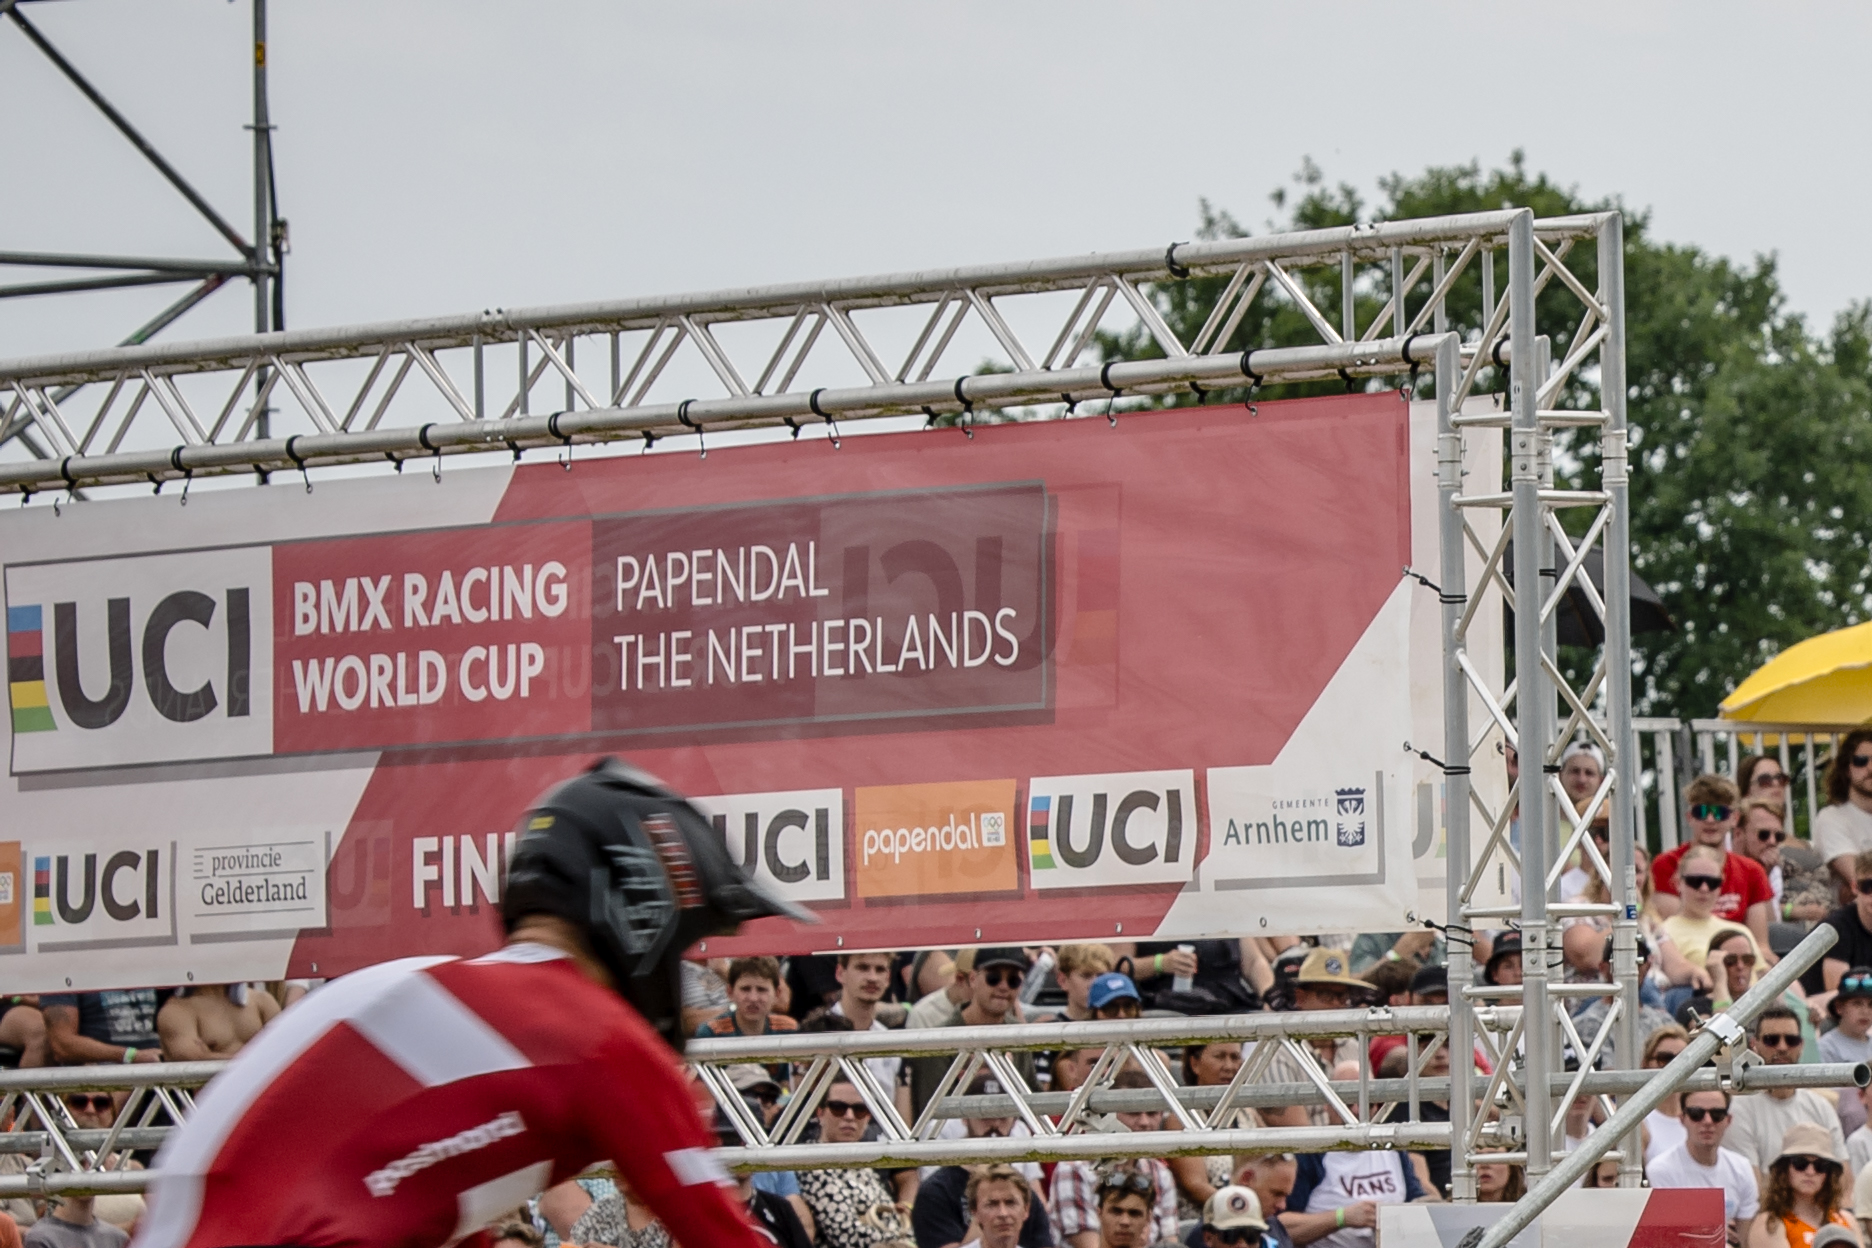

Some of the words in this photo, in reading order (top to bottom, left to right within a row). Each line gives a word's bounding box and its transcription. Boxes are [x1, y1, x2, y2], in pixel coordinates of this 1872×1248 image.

[294, 574, 393, 636] BMX
[403, 560, 568, 629] RACING
[615, 541, 829, 612] PAPENDAL
[53, 587, 250, 730] UCI
[292, 649, 447, 713] WORLD
[459, 642, 545, 702] CUP
[613, 630, 693, 691] THE
[707, 606, 1020, 685] NETHERLANDS
[864, 812, 979, 866] papendal
[1056, 789, 1183, 868] UCI
[1223, 813, 1330, 846] Arnhem
[1272, 798, 1330, 810] GEMEENTE
[56, 849, 159, 924] UCI
[201, 875, 308, 907] Gelderland
[211, 847, 282, 877] provincie
[1340, 1170, 1396, 1198] VANS
